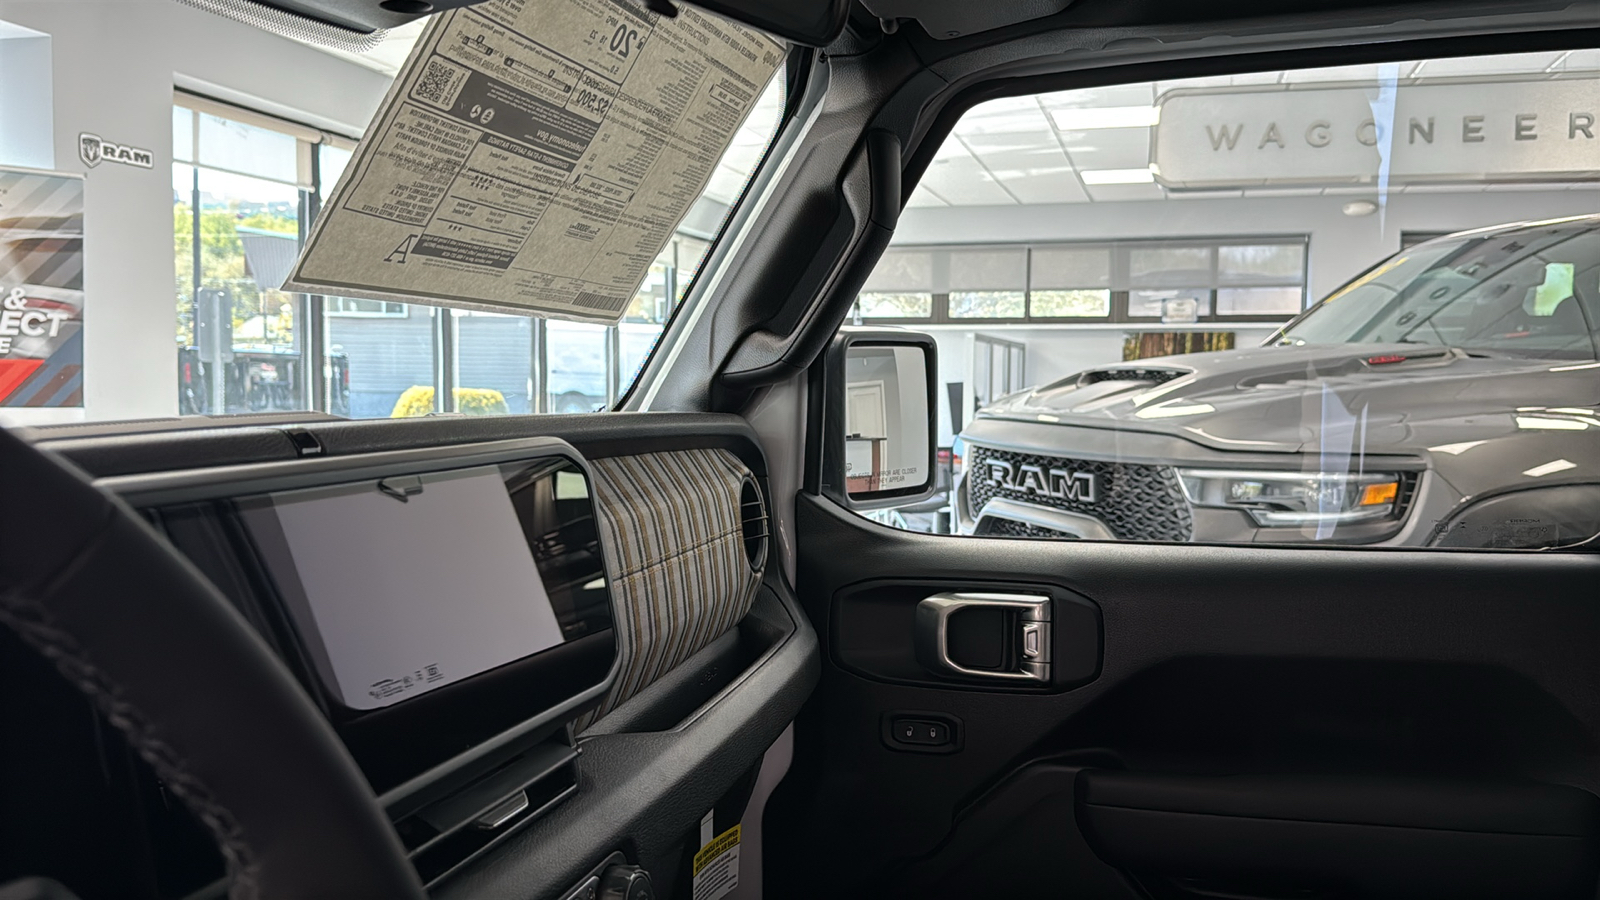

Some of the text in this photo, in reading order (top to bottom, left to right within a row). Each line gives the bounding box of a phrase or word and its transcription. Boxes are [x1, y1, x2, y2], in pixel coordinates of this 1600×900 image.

[677, 20, 709, 45] INSTRUCTIONS
[1205, 112, 1595, 151] WAGONEER
[102, 145, 151, 165] RAM
[985, 458, 1095, 502] RAM
[720, 829, 738, 845] EQUIPPED
